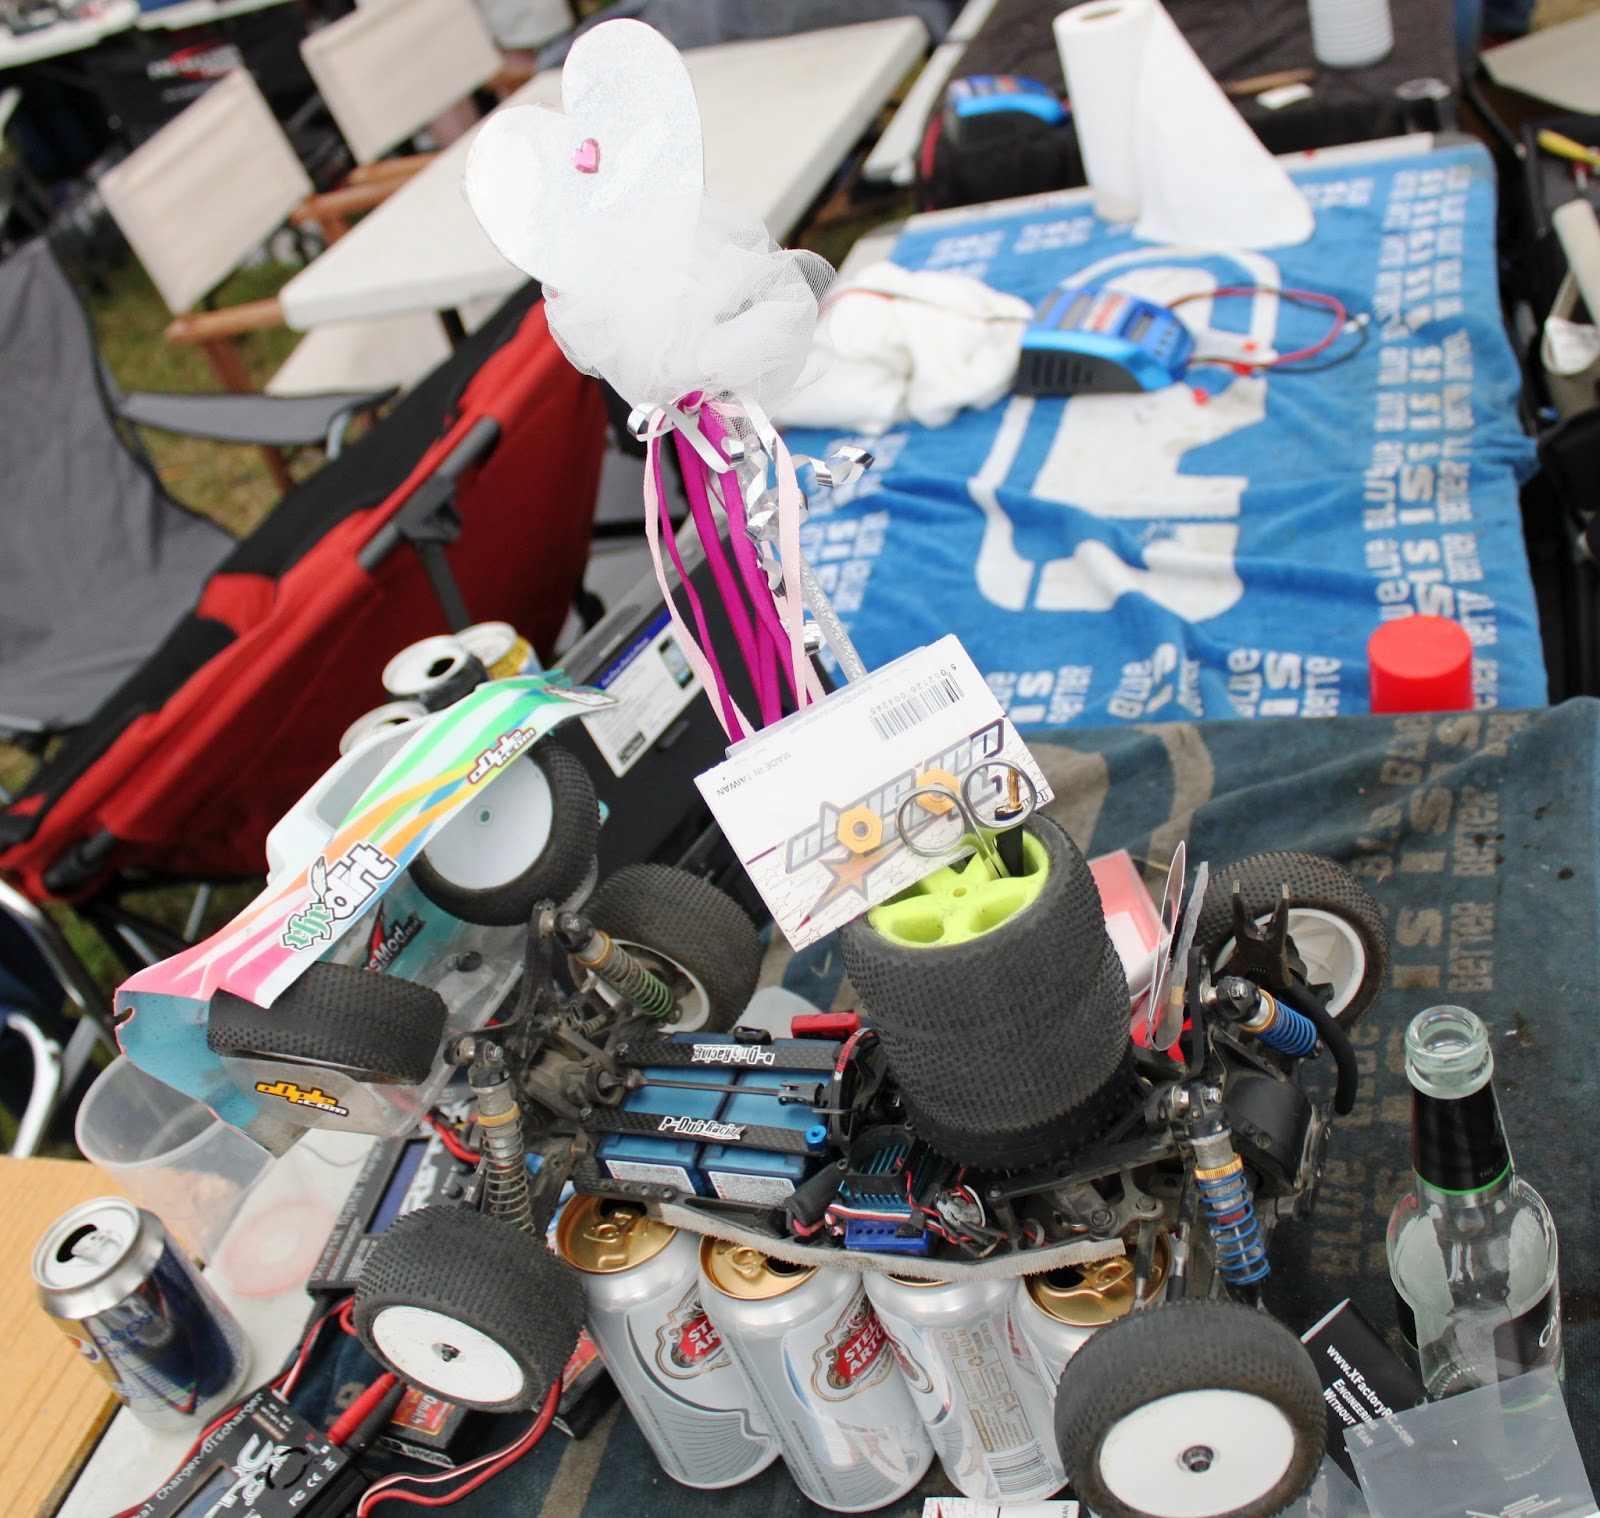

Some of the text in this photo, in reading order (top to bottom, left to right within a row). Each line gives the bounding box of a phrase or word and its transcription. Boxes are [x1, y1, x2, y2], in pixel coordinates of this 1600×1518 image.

[1399, 464, 1435, 525] IS
[1402, 539, 1444, 583] IS
[1009, 671, 1054, 724] IS
[1261, 651, 1303, 717] IS
[717, 769, 751, 797] TAIWAN
[765, 751, 791, 774] MADE
[1400, 786, 1453, 873] IS
[1392, 907, 1443, 989] IS
[1326, 1344, 1415, 1447] www.XFactoryRC.com
